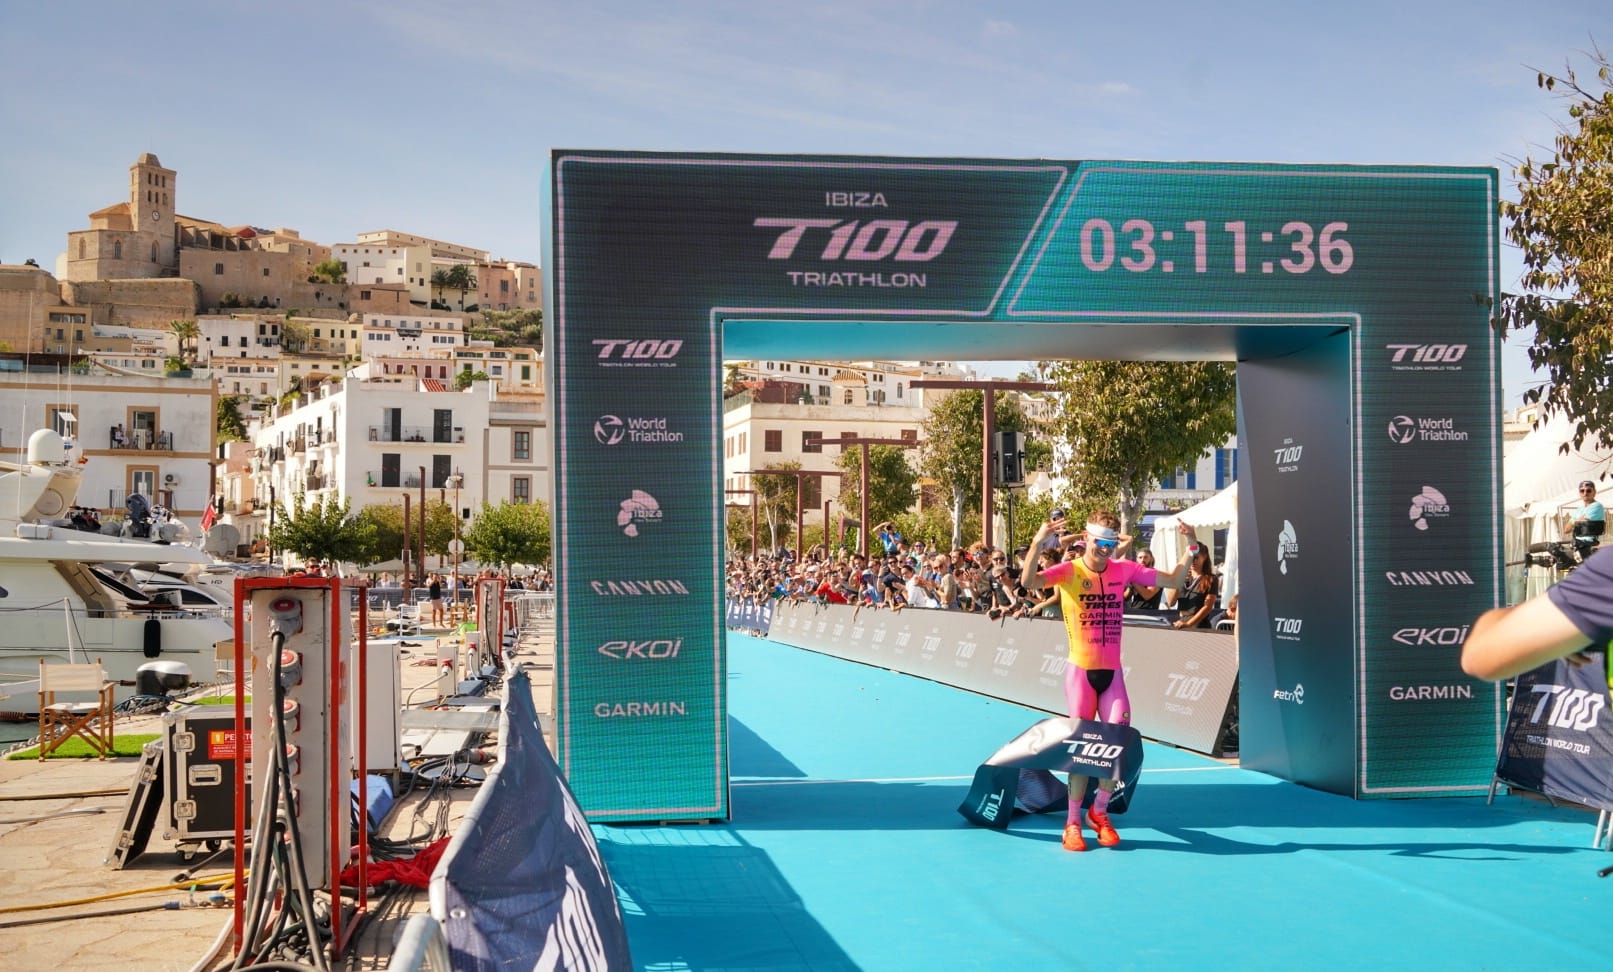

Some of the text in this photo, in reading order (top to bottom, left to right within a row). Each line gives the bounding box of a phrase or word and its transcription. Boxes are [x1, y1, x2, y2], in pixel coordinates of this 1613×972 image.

[825, 192, 888, 207] IBIZA
[753, 217, 959, 261] T100
[1080, 218, 1354, 274] 03:11:36
[786, 271, 926, 287] TRIATHLON
[592, 339, 683, 358] T100
[1386, 344, 1468, 362] T100
[627, 418, 667, 430] World
[1418, 418, 1453, 429] World
[627, 430, 684, 442] Triathlon
[1418, 430, 1468, 441] Triathlon
[1274, 445, 1303, 464] T100
[1385, 571, 1475, 586] CANYON
[590, 580, 690, 595] CANYON
[1084, 601, 1121, 609] TIRES
[1079, 612, 1121, 620] GARMIN
[1273, 617, 1303, 634] T100
[1165, 673, 1211, 702] T100
[1530, 684, 1605, 732] T100
[1083, 733, 1103, 741] IBIZA
[1062, 740, 1124, 759] T100
[1552, 739, 1574, 751] WORLD
[1573, 743, 1591, 755] TOUR
[1072, 756, 1112, 768] TRIATHLON
[982, 789, 1005, 822] T100
